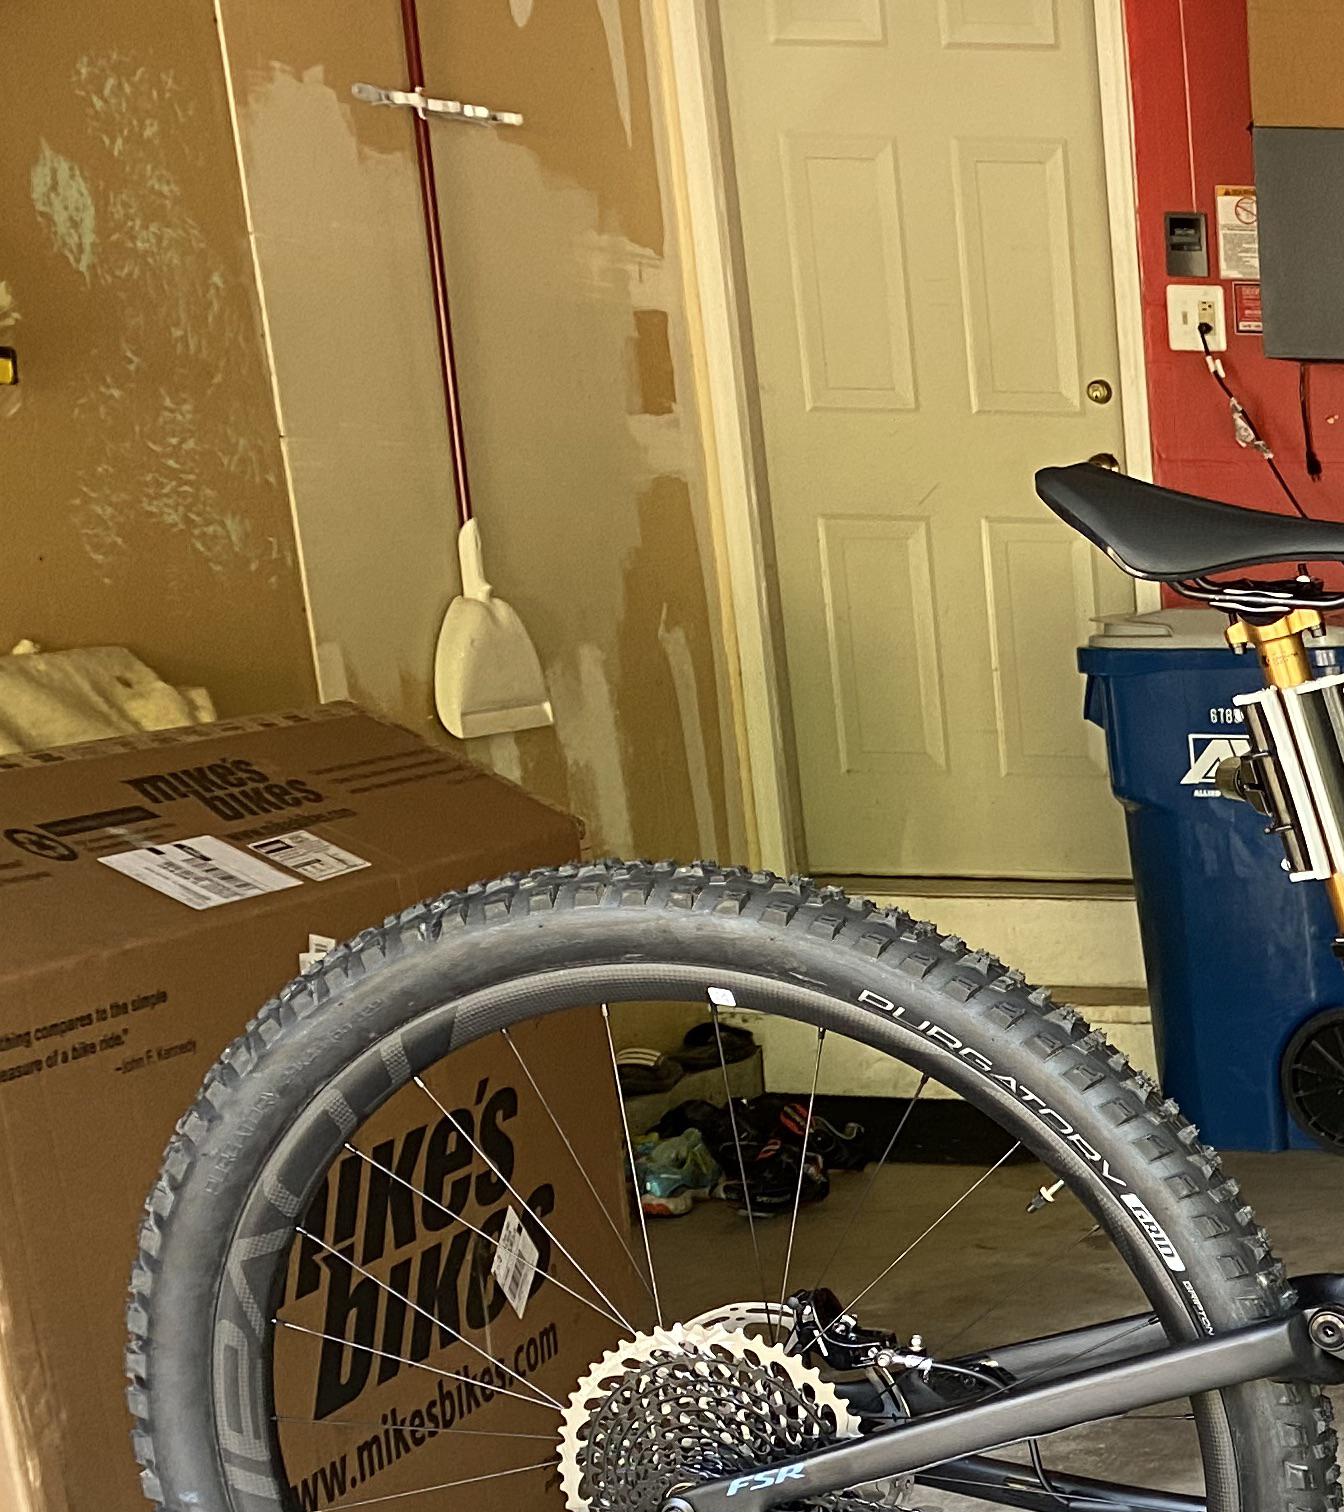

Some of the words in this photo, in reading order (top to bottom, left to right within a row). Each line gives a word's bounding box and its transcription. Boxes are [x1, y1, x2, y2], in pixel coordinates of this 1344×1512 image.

[857, 989, 1127, 1188] PURGATORY
[1132, 1206, 1177, 1258] GRID
[726, 1462, 806, 1497] FSR
